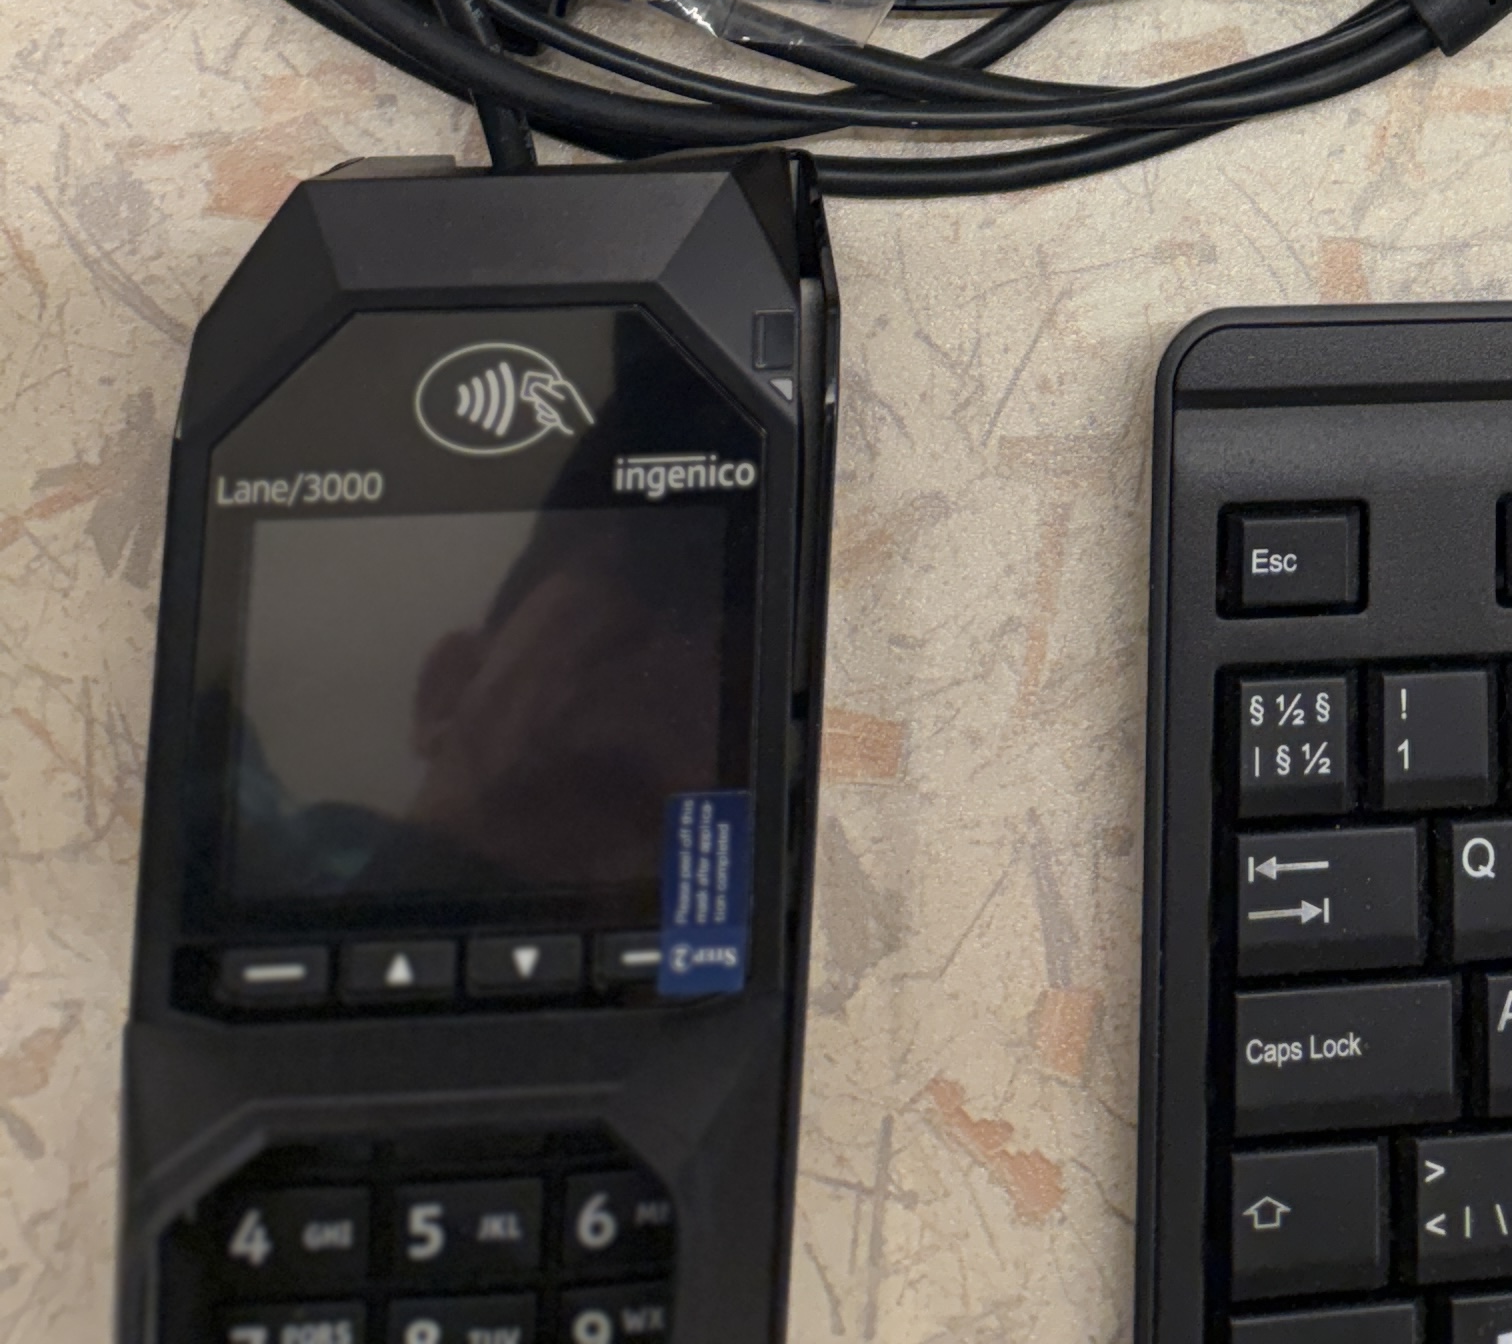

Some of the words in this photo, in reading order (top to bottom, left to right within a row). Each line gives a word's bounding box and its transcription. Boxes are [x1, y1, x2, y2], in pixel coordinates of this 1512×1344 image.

[215, 471, 383, 508] Lane/3000
[615, 455, 756, 498] ingenico
[1252, 549, 1297, 573] Esc
[1398, 739, 1409, 769] 1
[717, 823, 730, 892] completed
[1462, 838, 1495, 878] Q
[715, 894, 727, 922] tion
[1246, 1039, 1302, 1067] Caps
[1310, 1032, 1361, 1059] Lock
[228, 1208, 271, 1266] 4
[303, 1221, 354, 1250] GHI
[407, 1203, 445, 1260] 5
[477, 1212, 522, 1241] JKL
[576, 1192, 616, 1249] 6
